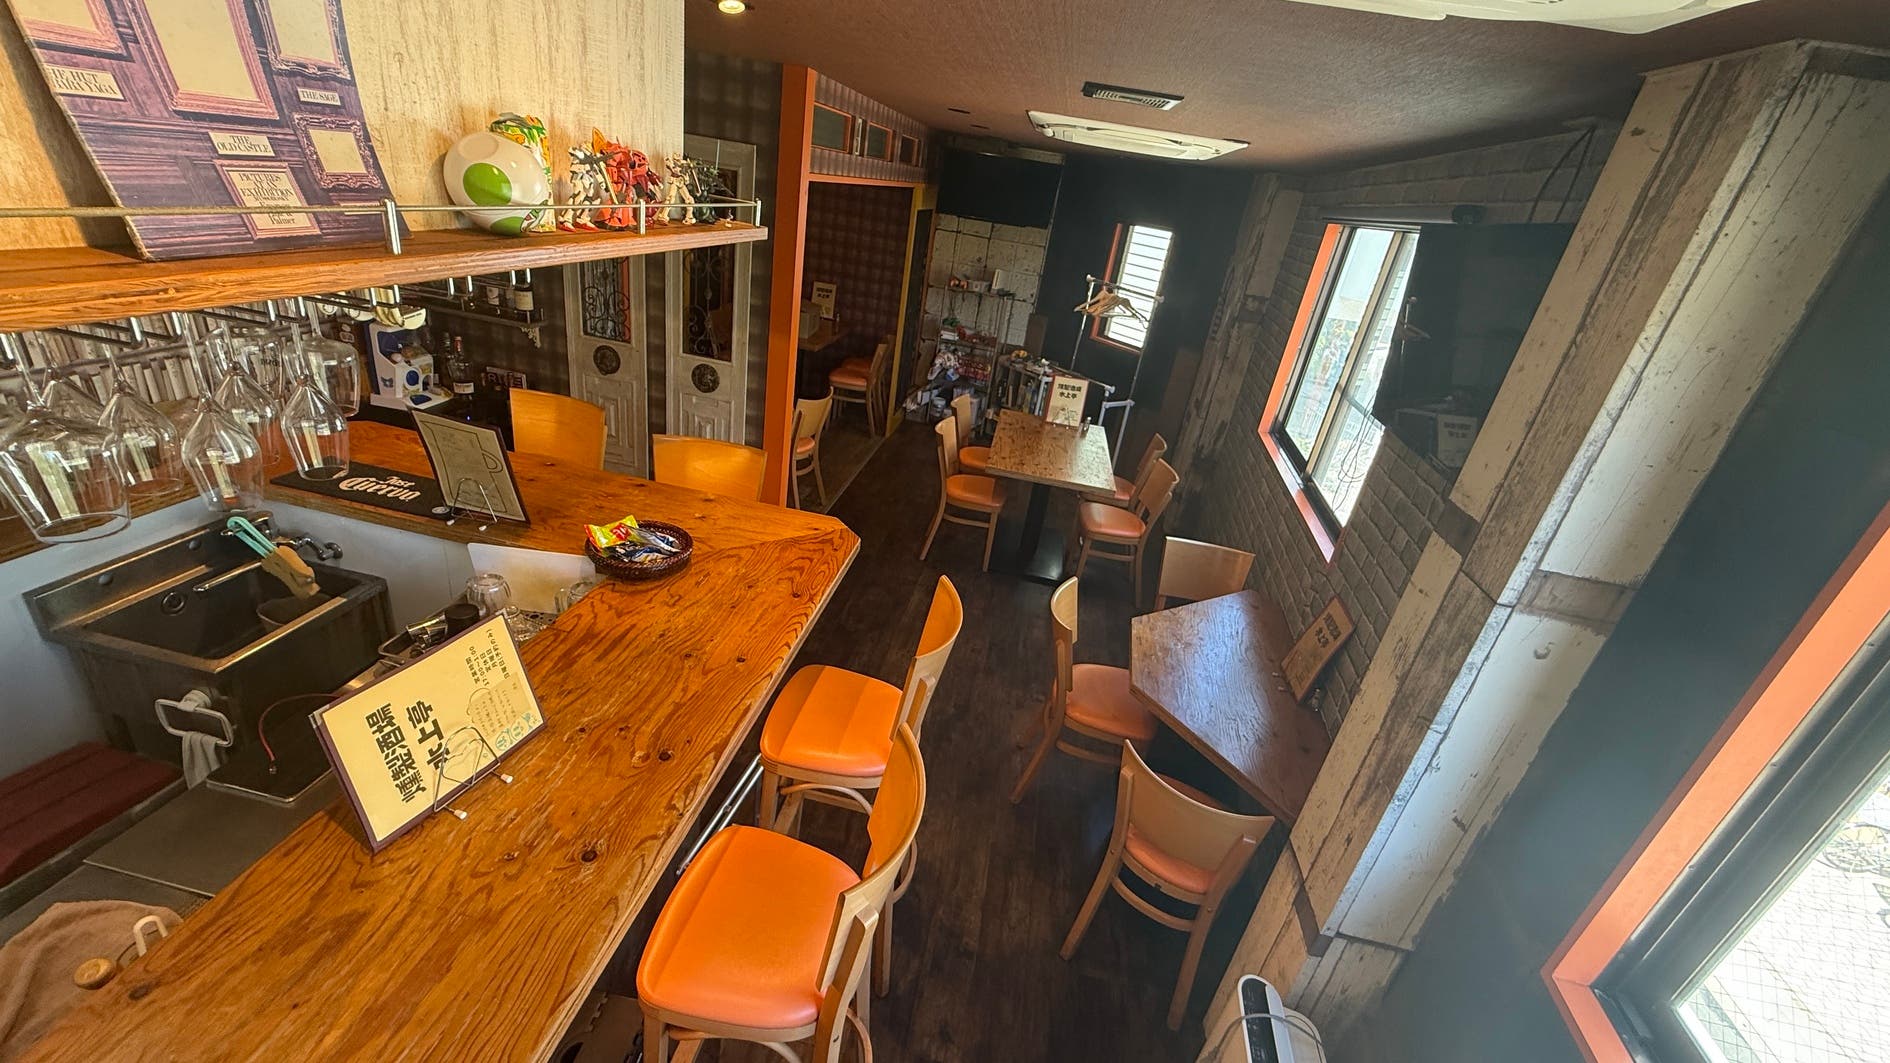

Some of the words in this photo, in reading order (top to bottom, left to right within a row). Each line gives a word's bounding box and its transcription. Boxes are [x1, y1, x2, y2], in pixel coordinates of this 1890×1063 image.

[69, 71, 98, 84] HUT
[84, 81, 118, 94] YAGA
[300, 91, 318, 100] THE
[229, 135, 251, 145] THE
[216, 142, 239, 152] OLD
[238, 143, 272, 153] CASTLE
[239, 173, 281, 181] PICTURES
[240, 188, 294, 198] EXHIBITION
[338, 477, 421, 501] Cuervo
[406, 700, 450, 771] 水上亭
[366, 703, 427, 804] 燻製酒場
